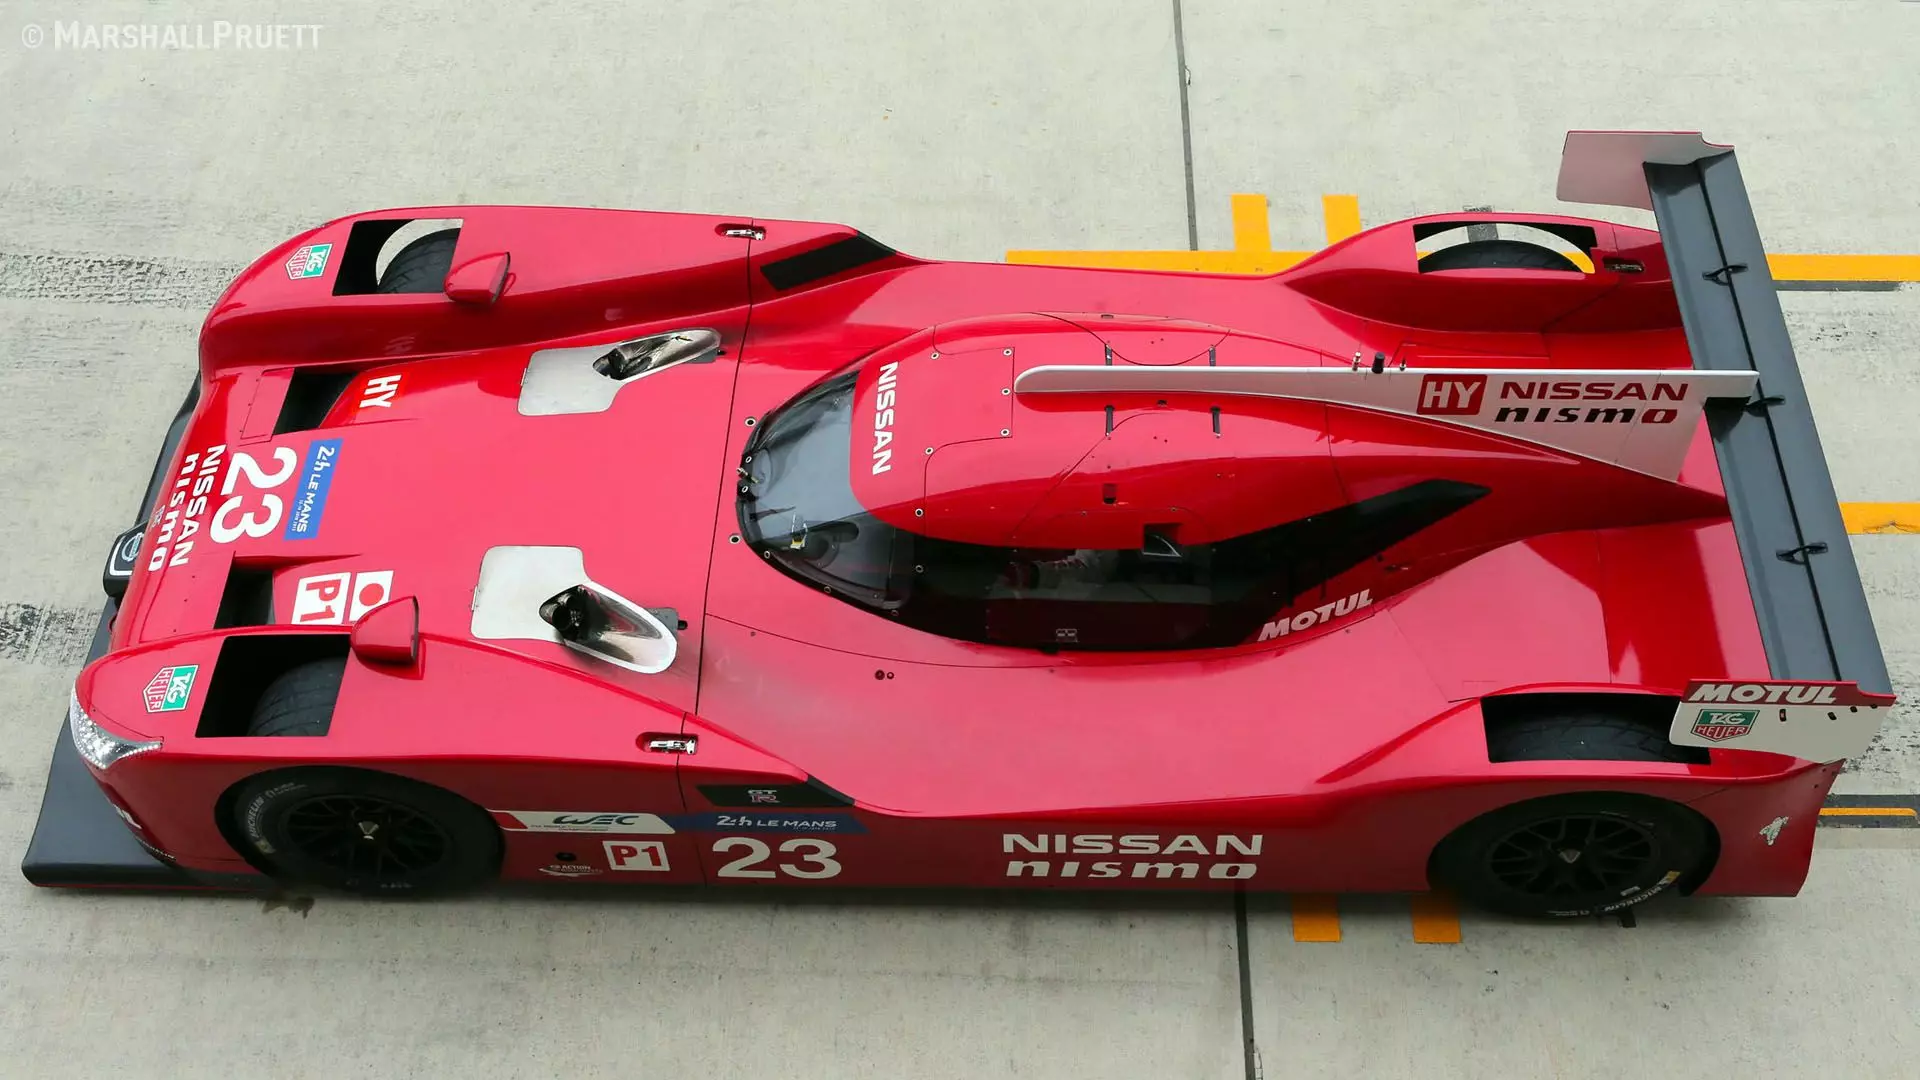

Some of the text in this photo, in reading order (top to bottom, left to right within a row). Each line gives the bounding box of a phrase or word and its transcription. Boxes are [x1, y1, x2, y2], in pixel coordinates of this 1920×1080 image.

[288, 248, 311, 278] HEUER
[306, 248, 329, 273] TAG
[359, 374, 402, 409] HY
[1421, 380, 1481, 409] HY
[1499, 381, 1689, 401] NISSAN
[872, 361, 899, 475] NISSAN
[1494, 407, 1679, 424] nismo
[210, 446, 298, 544] 23
[307, 473, 322, 491] LE
[148, 452, 200, 572] nismo
[169, 444, 227, 568] NISSAN
[296, 491, 317, 533] MANS
[299, 578, 342, 623] P1
[1257, 588, 1374, 642] MOTUL
[147, 670, 172, 710] HEUER
[166, 672, 192, 703] TAG
[1688, 683, 1838, 705] MOTUL
[1708, 711, 1747, 725] TAG
[1696, 726, 1748, 740] HEUER
[552, 814, 640, 826] WEC
[756, 819, 778, 827] LE
[782, 820, 838, 828] MANS
[609, 844, 662, 867] P1
[712, 836, 842, 880] 23
[1002, 833, 1264, 856] NISSAN
[1005, 860, 1258, 880] nismo
